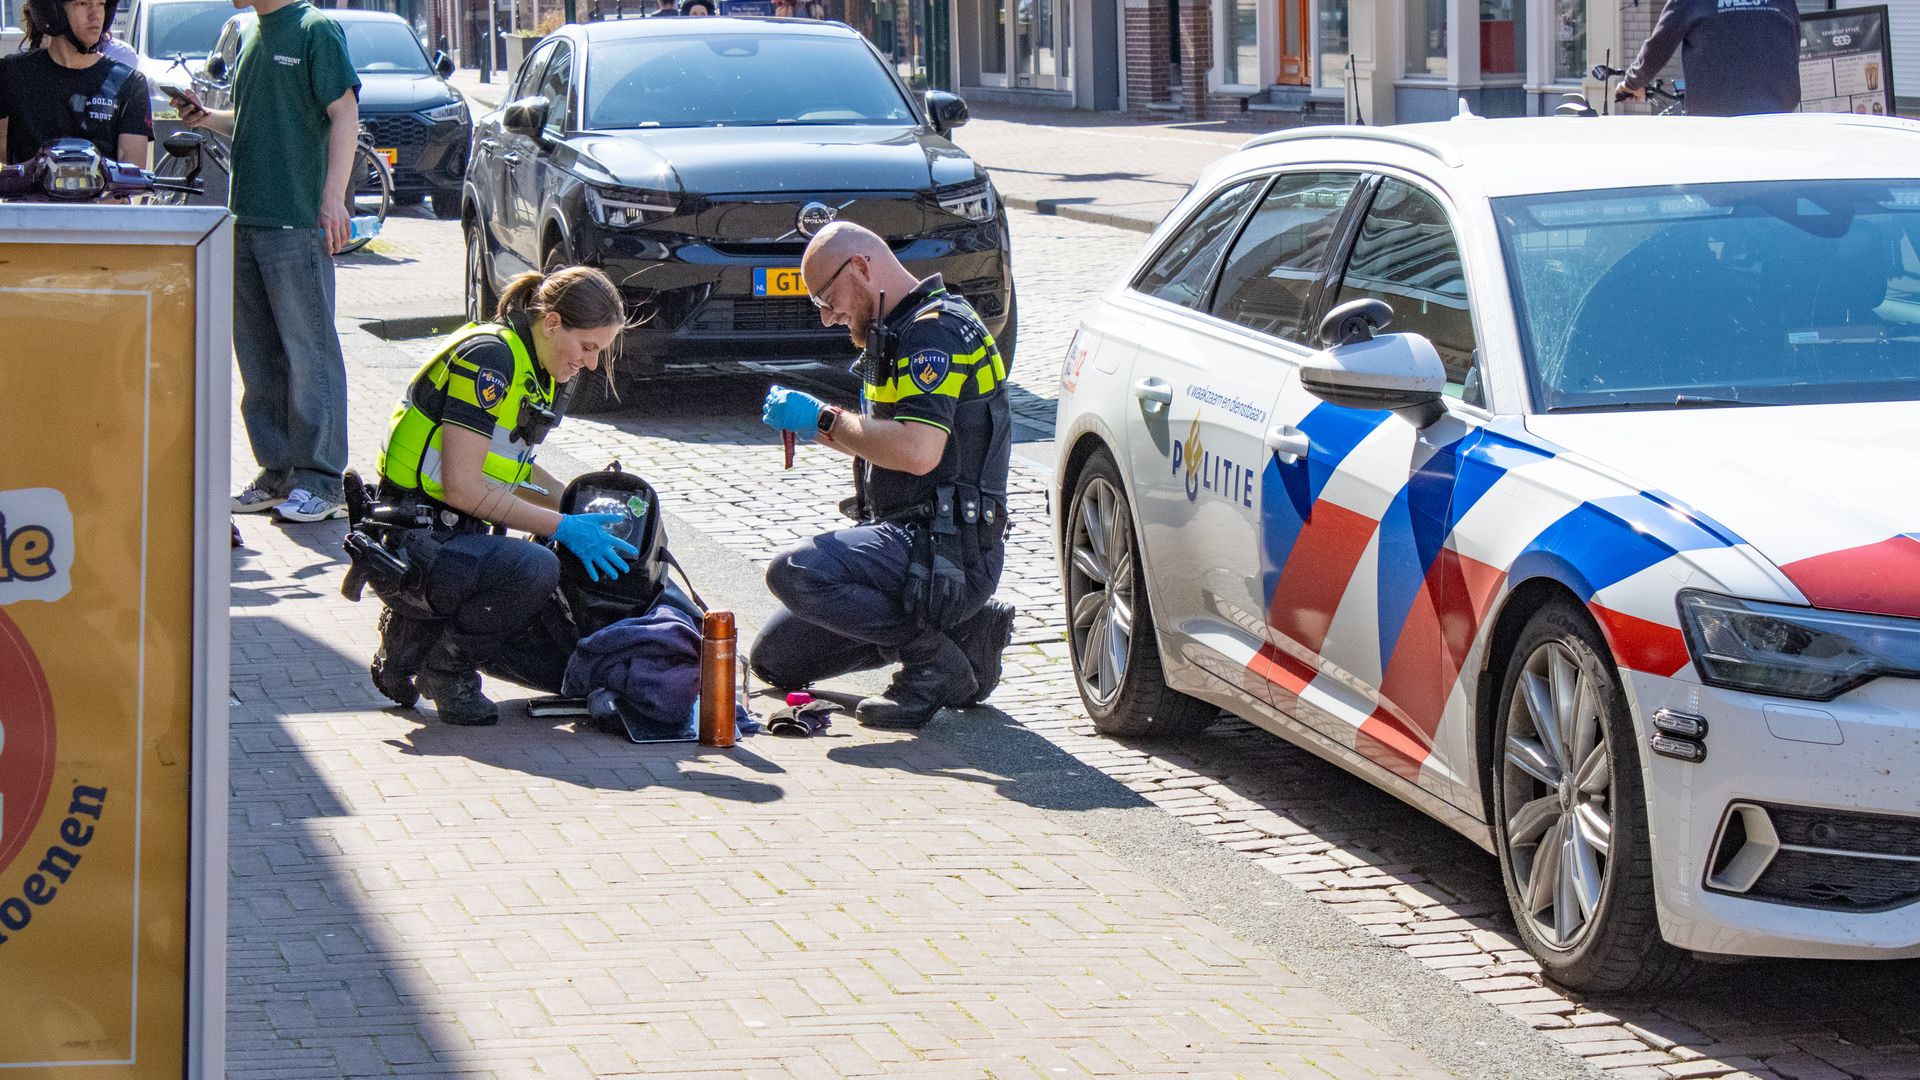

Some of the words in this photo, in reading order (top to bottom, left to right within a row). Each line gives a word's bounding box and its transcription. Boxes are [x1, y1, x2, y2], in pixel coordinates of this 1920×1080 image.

[92, 97, 112, 106] GOLD
[90, 111, 112, 120] TRUST
[776, 272, 808, 291] GT
[914, 356, 945, 364] POLITIE
[482, 372, 505, 388] POLITIE
[1172, 439, 1254, 508] POLITIE
[0, 784, 108, 945] oenen
